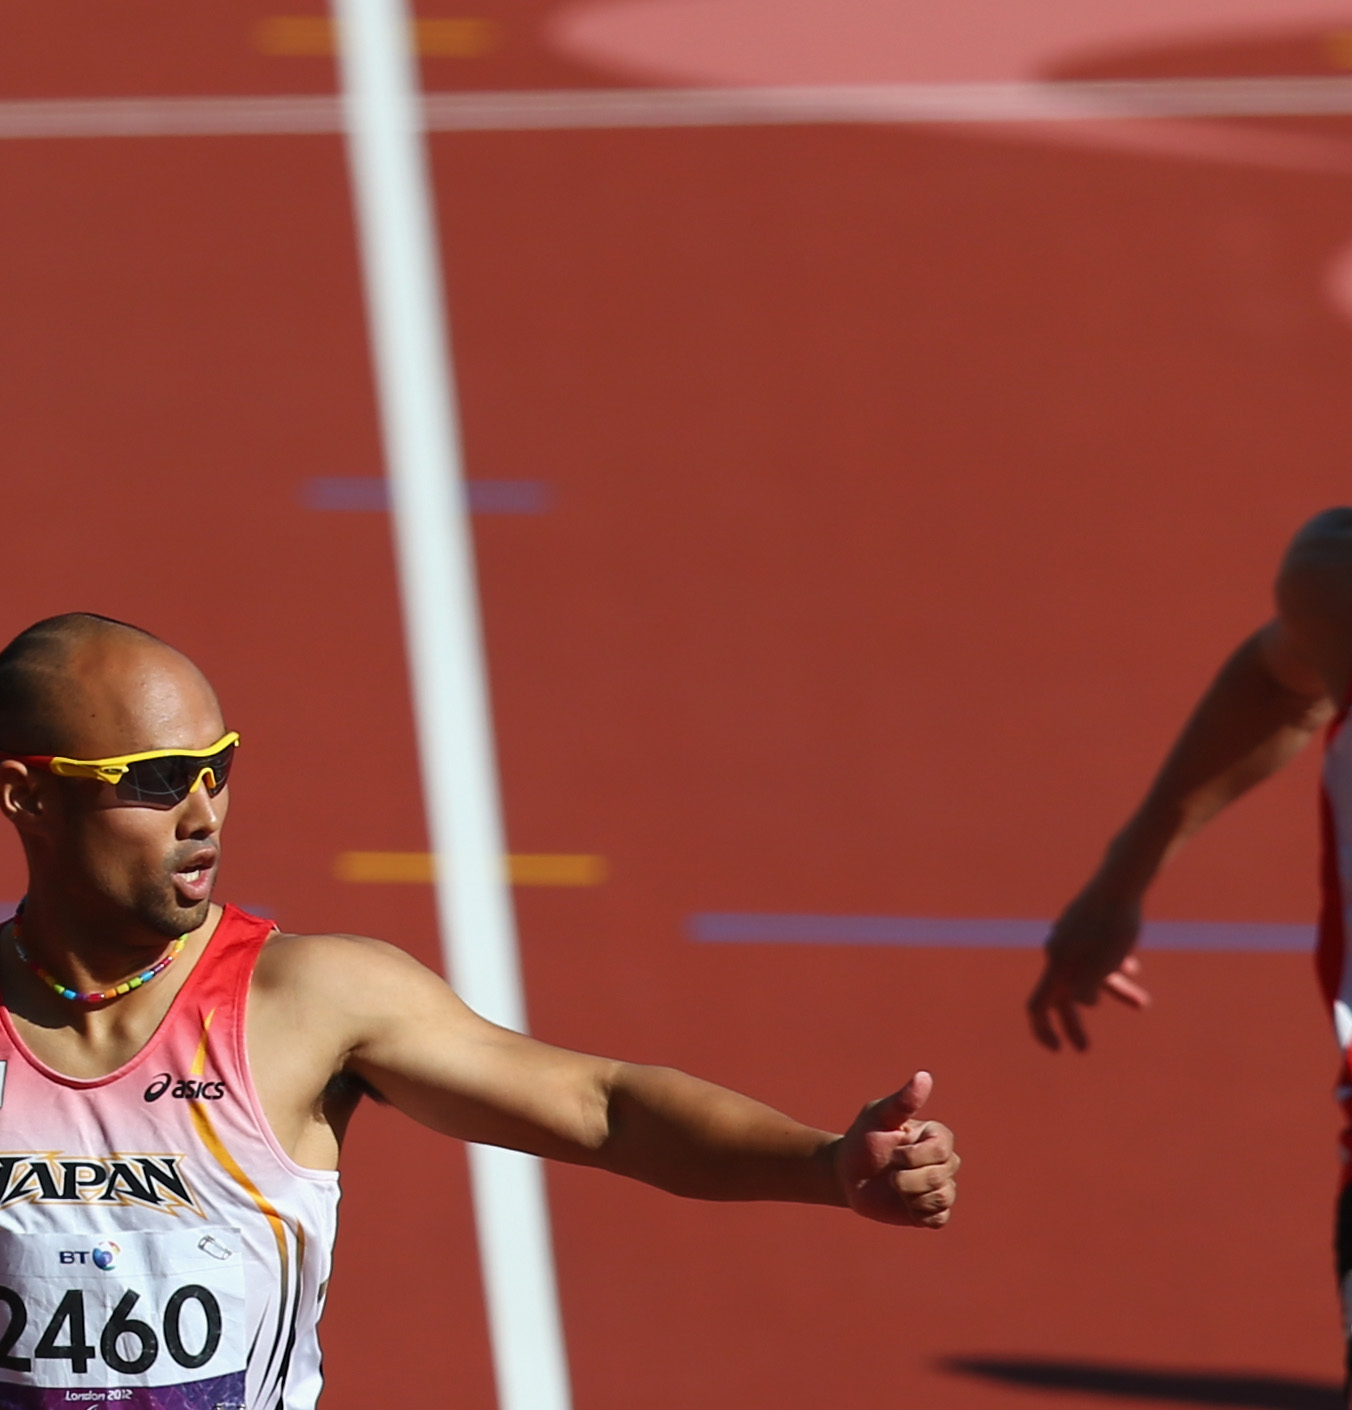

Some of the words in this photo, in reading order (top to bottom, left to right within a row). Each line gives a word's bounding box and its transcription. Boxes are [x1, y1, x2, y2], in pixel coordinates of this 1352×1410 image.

[171, 1079, 225, 1100] asics
[59, 1251, 89, 1265] BT
[65, 1390, 105, 1401] London
[107, 1389, 133, 1401] 2012
